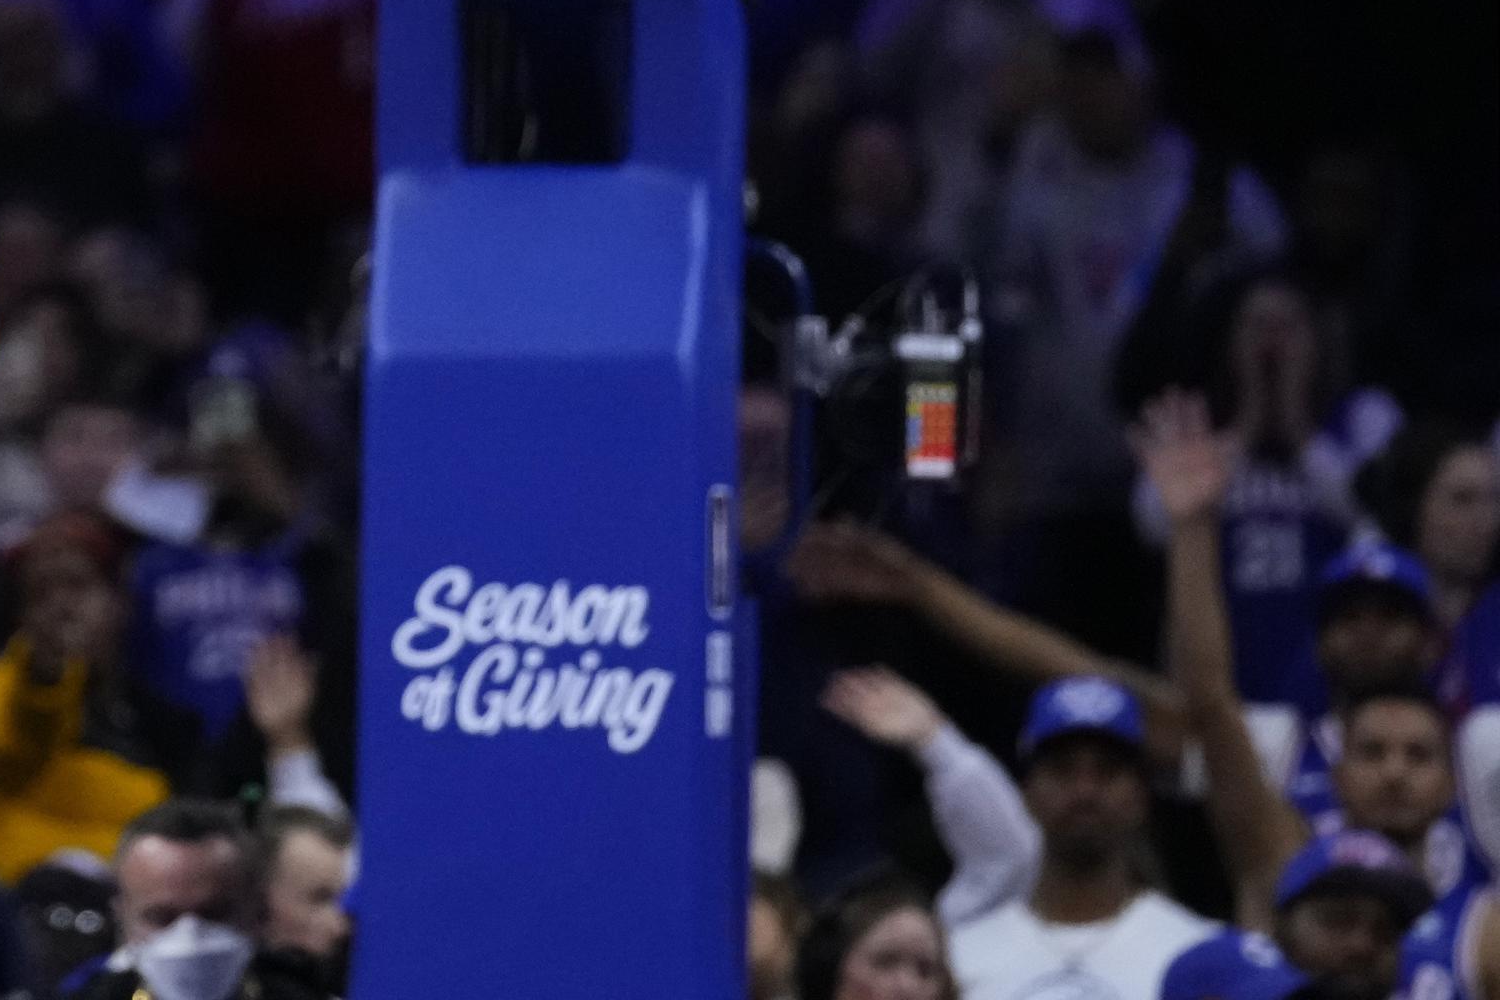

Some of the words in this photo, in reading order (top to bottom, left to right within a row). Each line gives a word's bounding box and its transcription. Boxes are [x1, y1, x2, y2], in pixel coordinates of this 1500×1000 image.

[392, 565, 649, 668] Season
[401, 665, 454, 731] of
[455, 643, 675, 753] Giving
